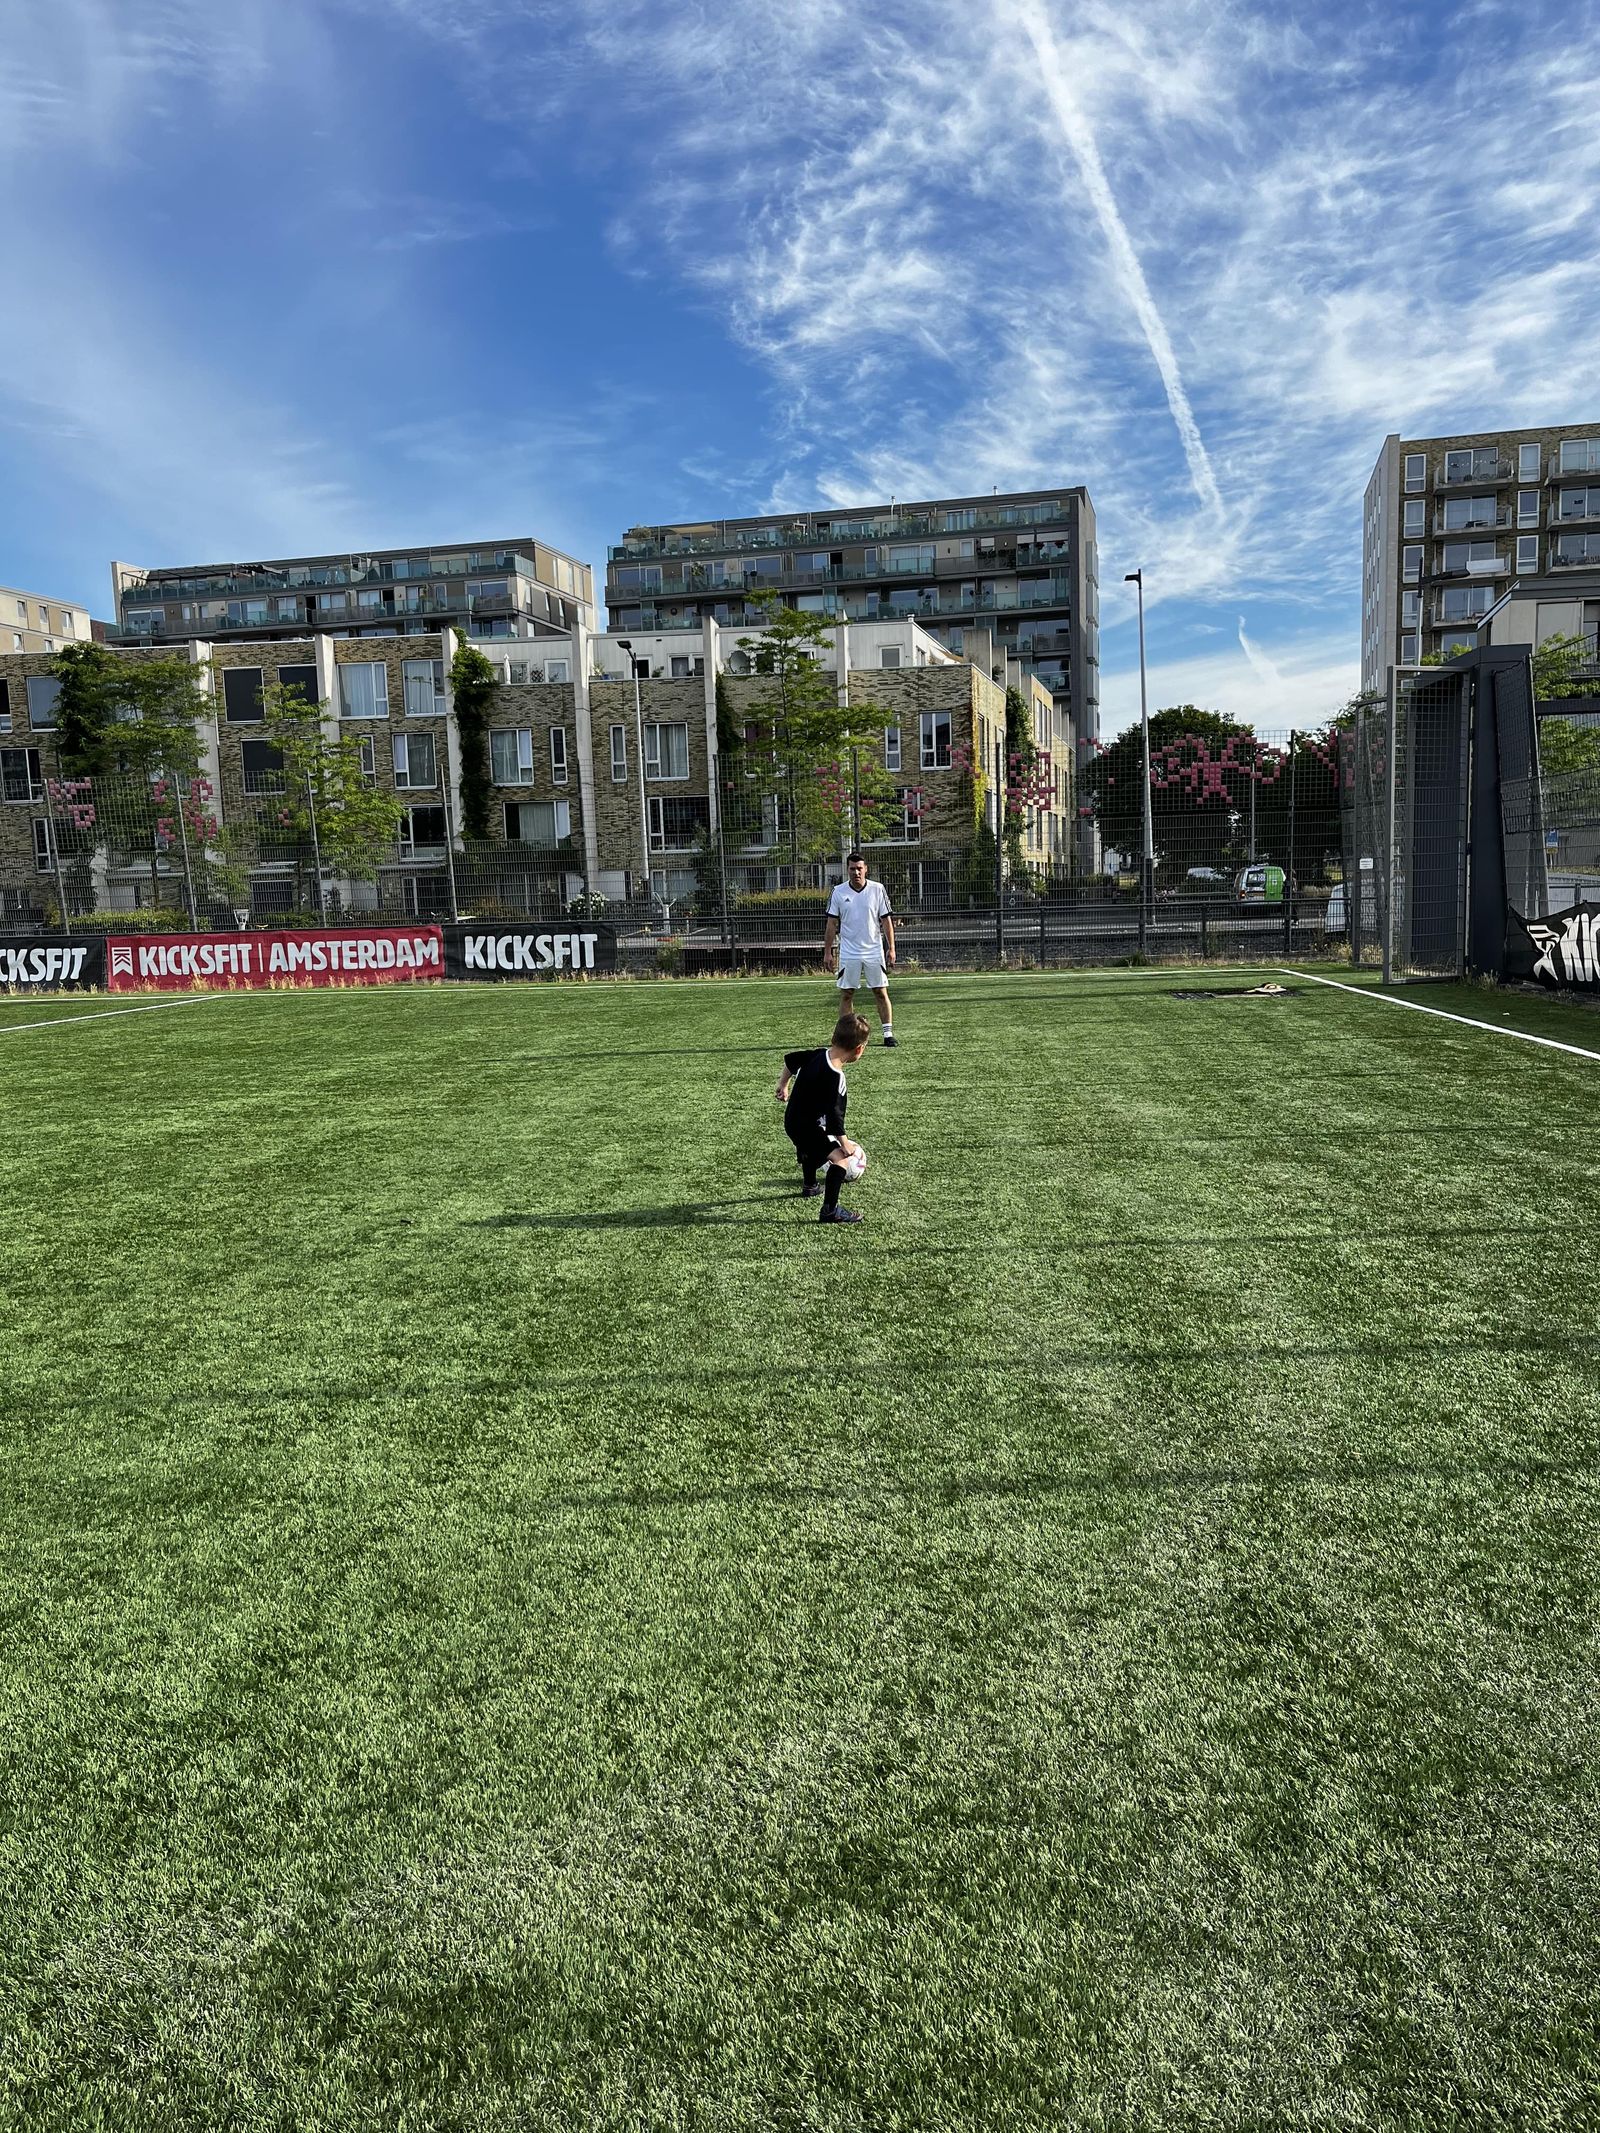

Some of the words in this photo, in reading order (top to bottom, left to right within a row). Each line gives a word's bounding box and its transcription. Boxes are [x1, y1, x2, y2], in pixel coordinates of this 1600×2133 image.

[138, 943, 252, 976] KICKSFIT
[269, 937, 439, 972] AMSTERDAM
[464, 933, 598, 970] KICKSFIT
